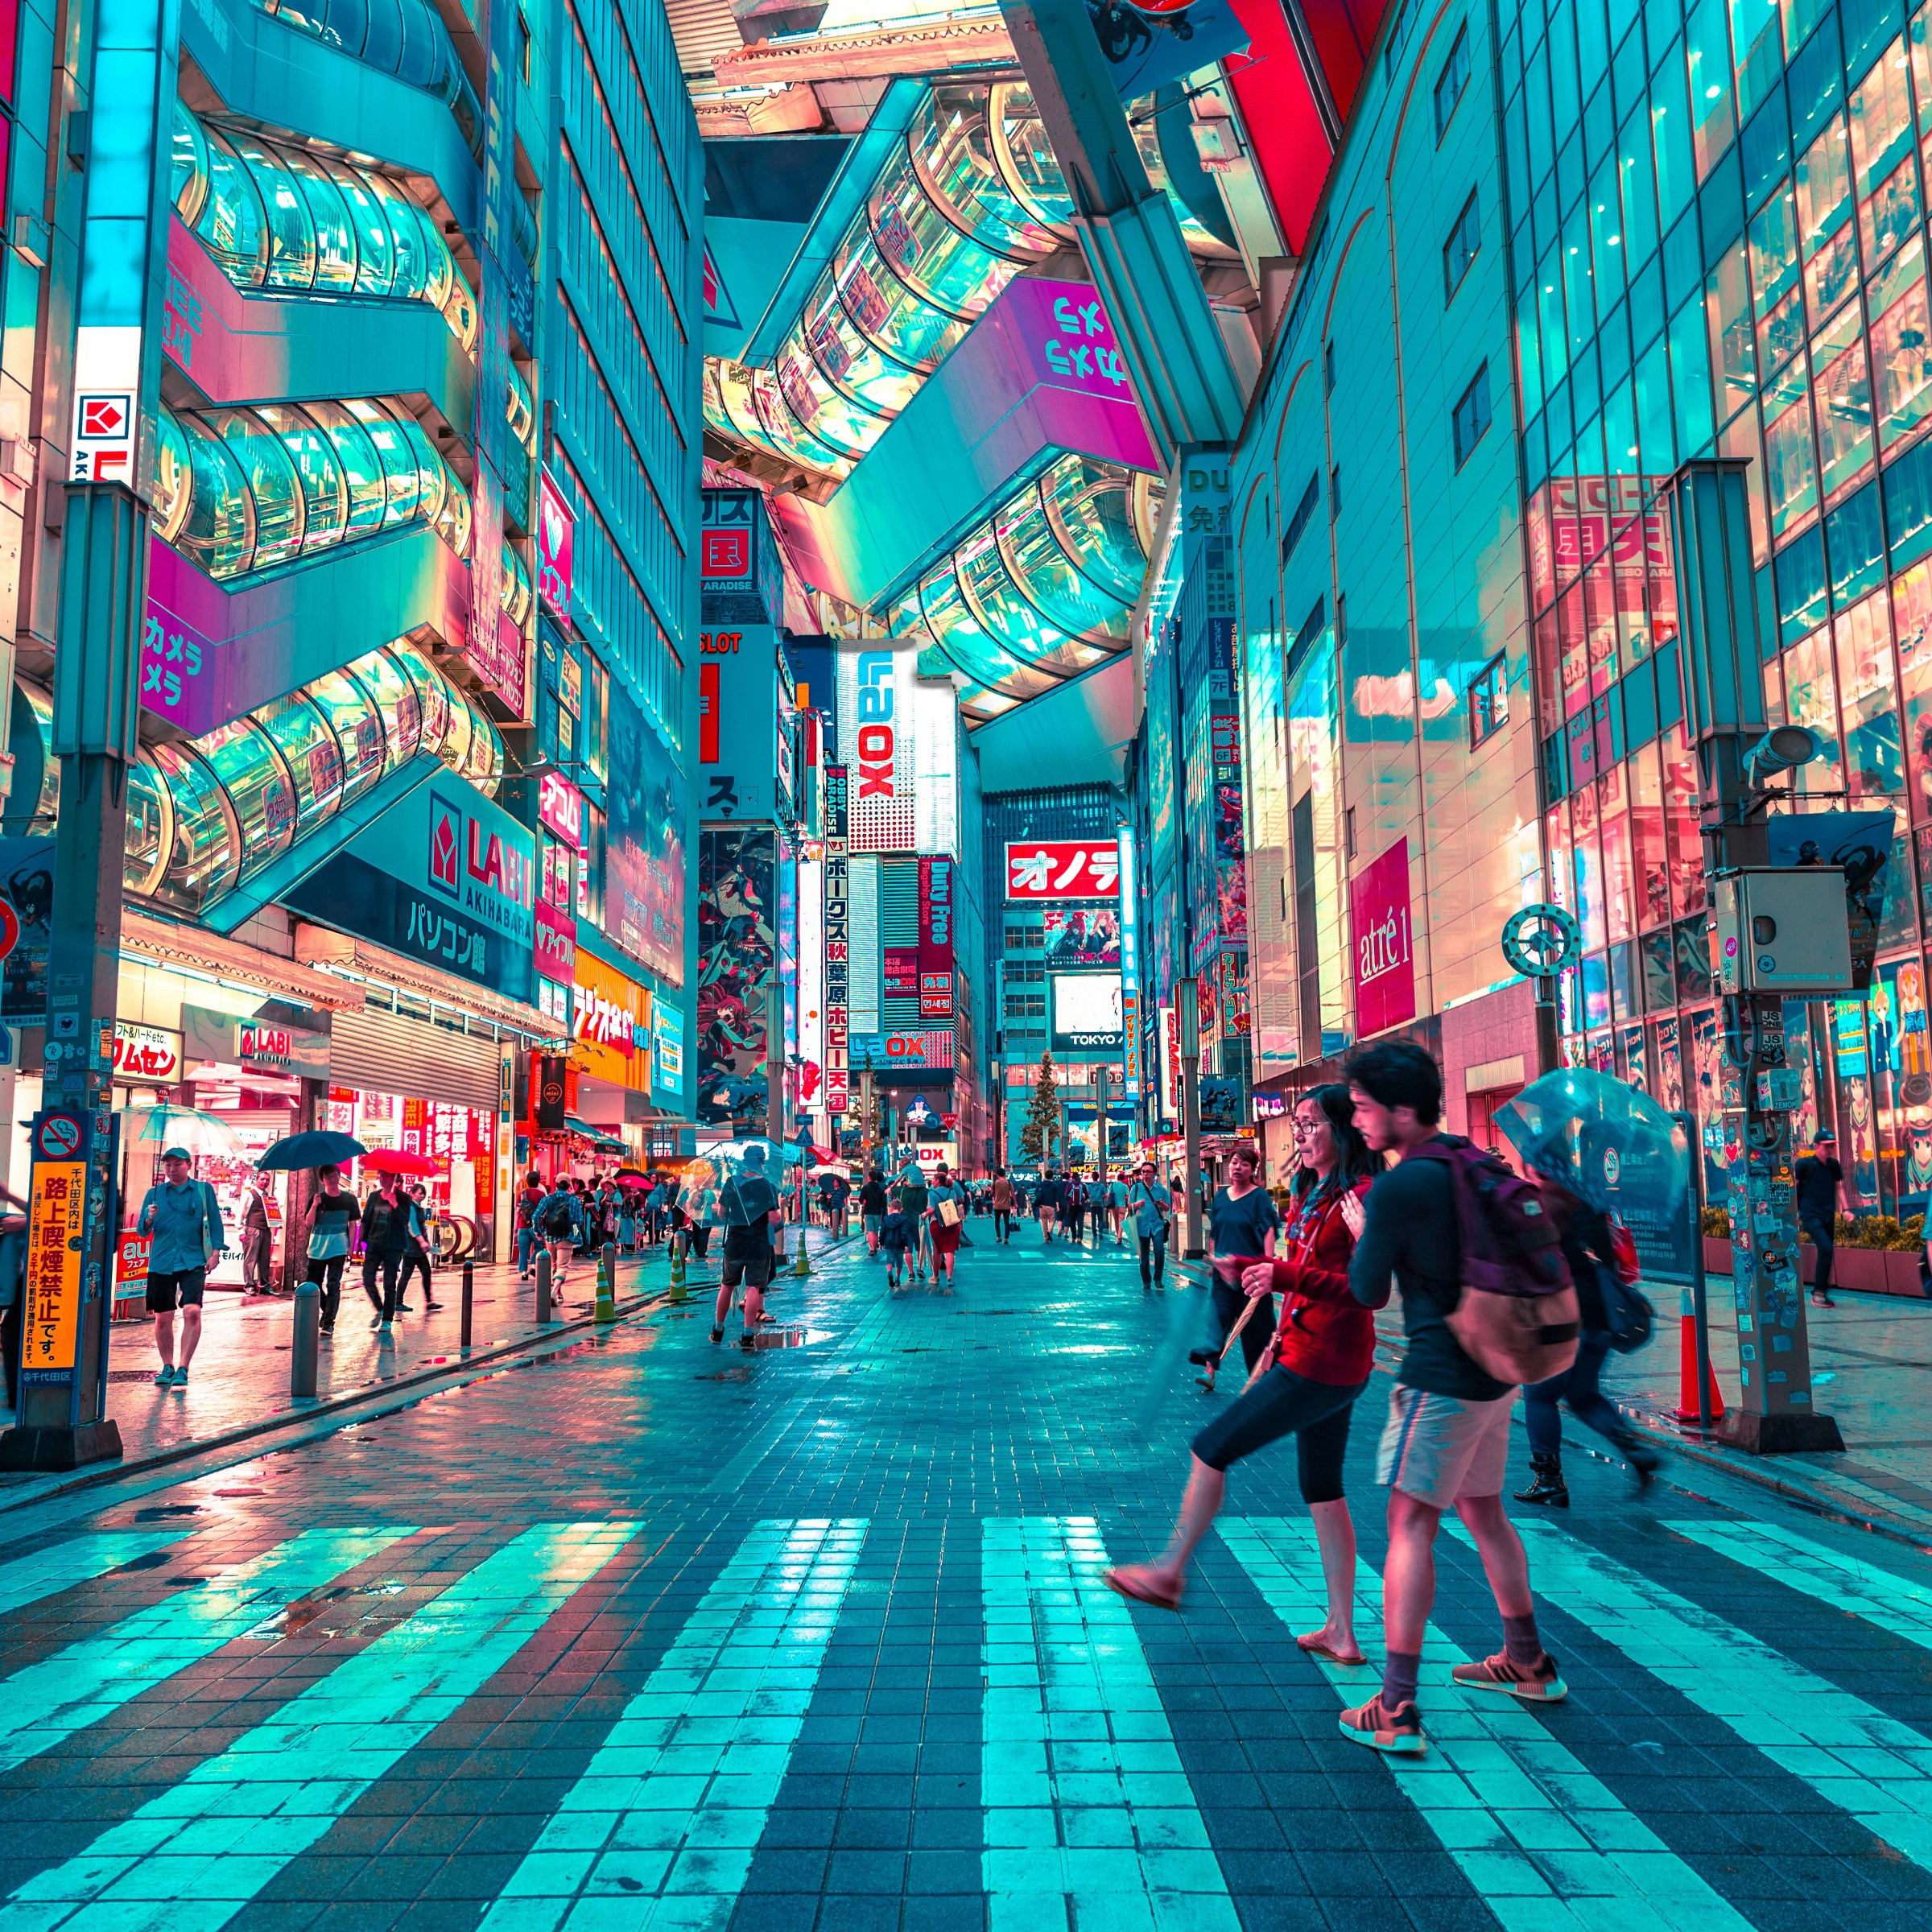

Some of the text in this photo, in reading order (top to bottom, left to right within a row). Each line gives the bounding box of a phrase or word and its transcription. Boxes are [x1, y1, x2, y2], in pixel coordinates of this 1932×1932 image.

[1189, 470, 1228, 493] DU
[1212, 681, 1224, 692] 7F
[1216, 751, 1229, 761] 6F
[828, 768, 837, 834] PARADISE
[836, 768, 846, 813] HOBBY
[543, 774, 580, 837] アコム
[468, 815, 531, 910] LABI
[465, 890, 532, 939] AKIHABARA
[931, 861, 950, 945] Duty Free
[407, 901, 486, 976] パソコン館
[547, 925, 576, 967] アイフル
[1360, 905, 1398, 980] atré
[1763, 1012, 1780, 1021] JS
[257, 1028, 292, 1055] LABI
[1070, 1034, 1116, 1046] TOKYO
[1765, 1034, 1781, 1043] JS
[257, 1052, 291, 1067] AKIHABARA
[896, 1148, 944, 1161] LOX
[68, 1167, 83, 1230] 千代田区内は
[123, 1241, 151, 1260] au
[126, 1259, 146, 1269] フェア
[38, 1177, 68, 1362] 路上喫煙禁止です。
[31, 1371, 72, 1382] 千代田区
